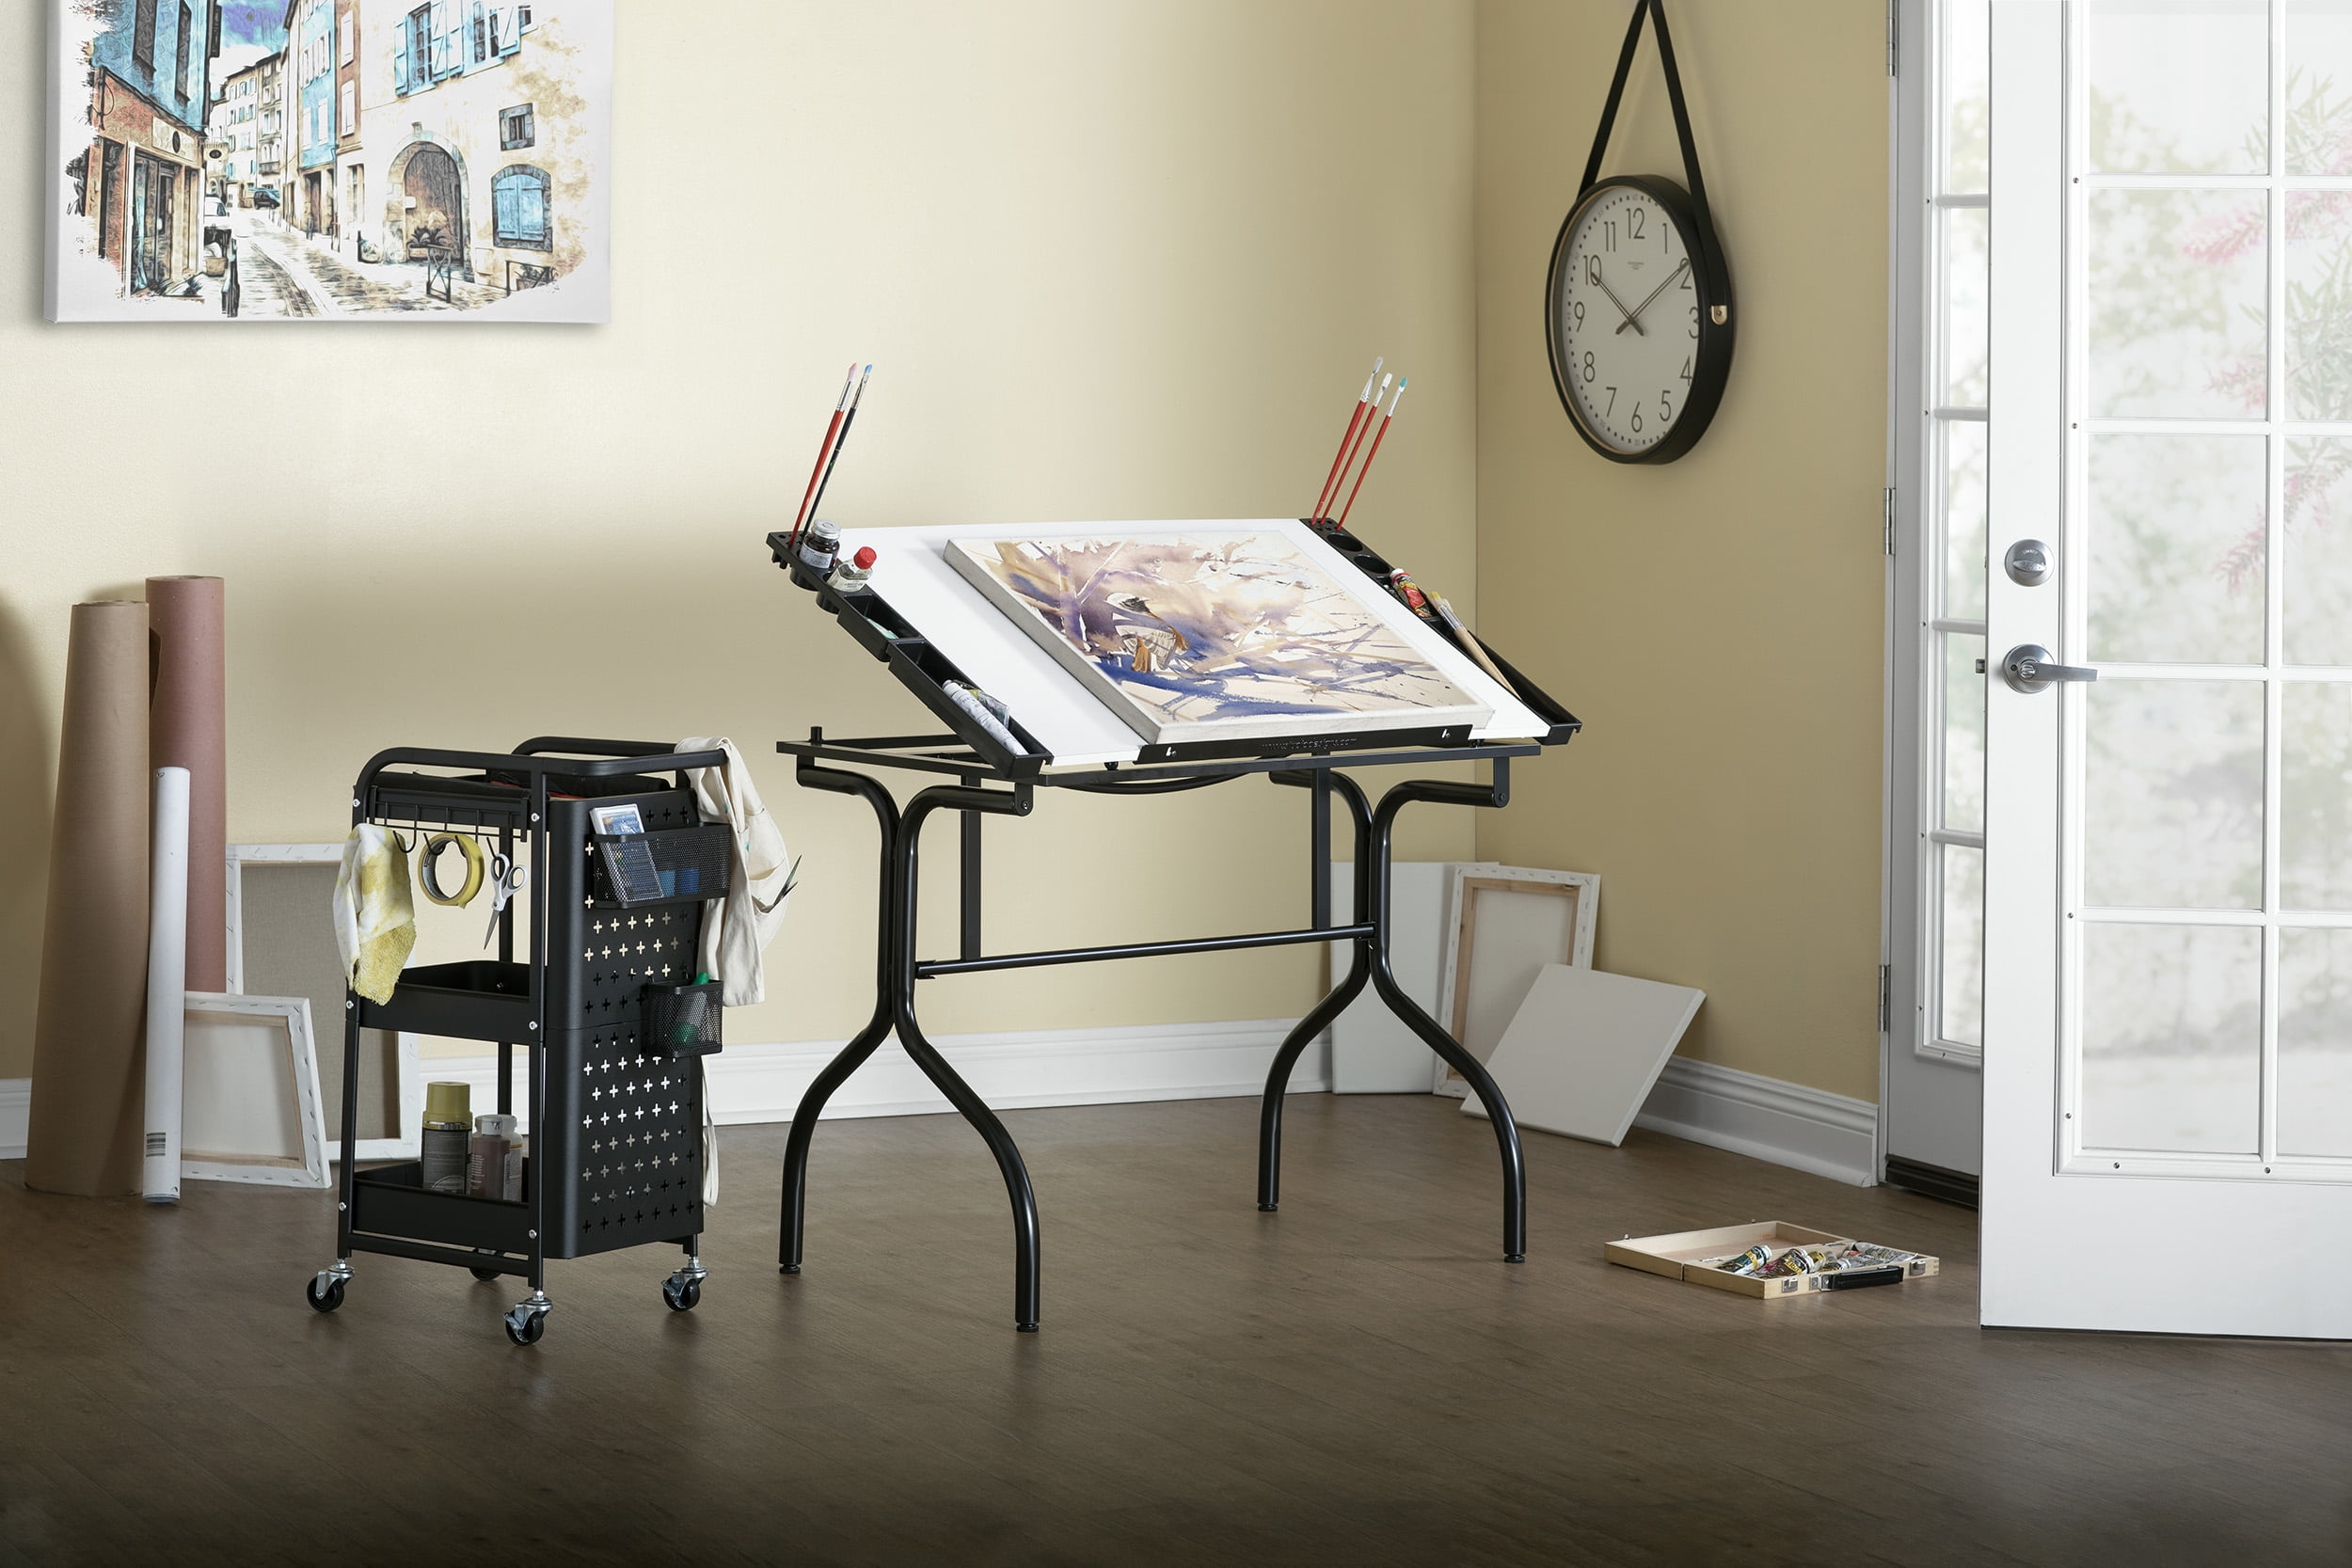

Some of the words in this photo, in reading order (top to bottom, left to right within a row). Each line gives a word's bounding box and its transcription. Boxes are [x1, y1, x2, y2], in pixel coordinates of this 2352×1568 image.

[1603, 221, 1616, 253] 11
[1626, 208, 1645, 239] 12
[1661, 222, 1669, 254] 1
[1582, 254, 1602, 287] 10
[1680, 257, 1692, 290] 2
[1574, 301, 1585, 333] 9
[1689, 306, 1699, 340] 3
[1583, 351, 1596, 383] 8
[1679, 356, 1693, 387] 4
[1606, 387, 1617, 418] 7
[1631, 402, 1643, 433] 6
[1660, 390, 1672, 422] 5
